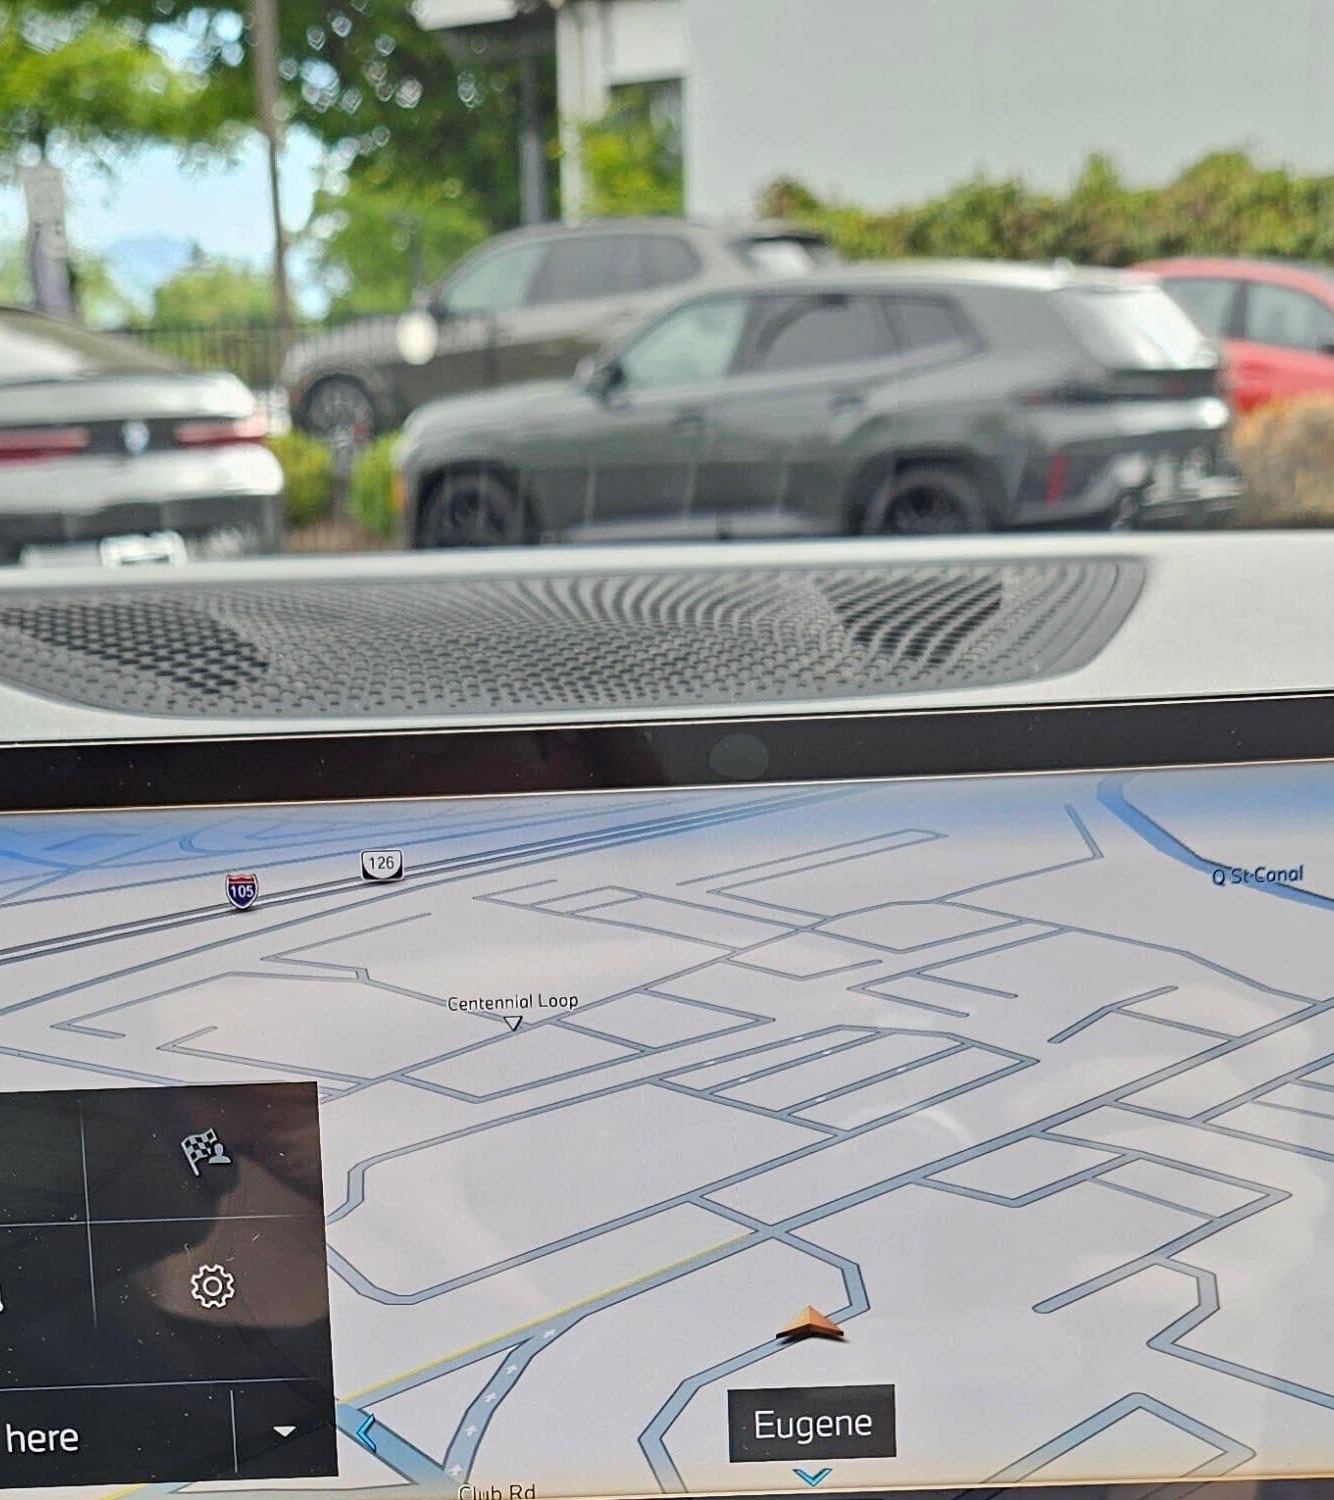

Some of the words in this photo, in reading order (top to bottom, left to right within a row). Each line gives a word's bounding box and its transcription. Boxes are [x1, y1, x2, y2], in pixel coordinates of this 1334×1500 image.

[368, 855, 395, 871] 126
[1212, 868, 1226, 886] Q
[1231, 868, 1249, 883] St
[1254, 865, 1303, 883] Canal
[230, 884, 254, 899] 105
[447, 994, 533, 1012] Centennial
[539, 992, 579, 1010] Loop
[754, 1409, 873, 1445] Eugene
[6, 1423, 80, 1454] here
[509, 1483, 537, 1500] Rd
